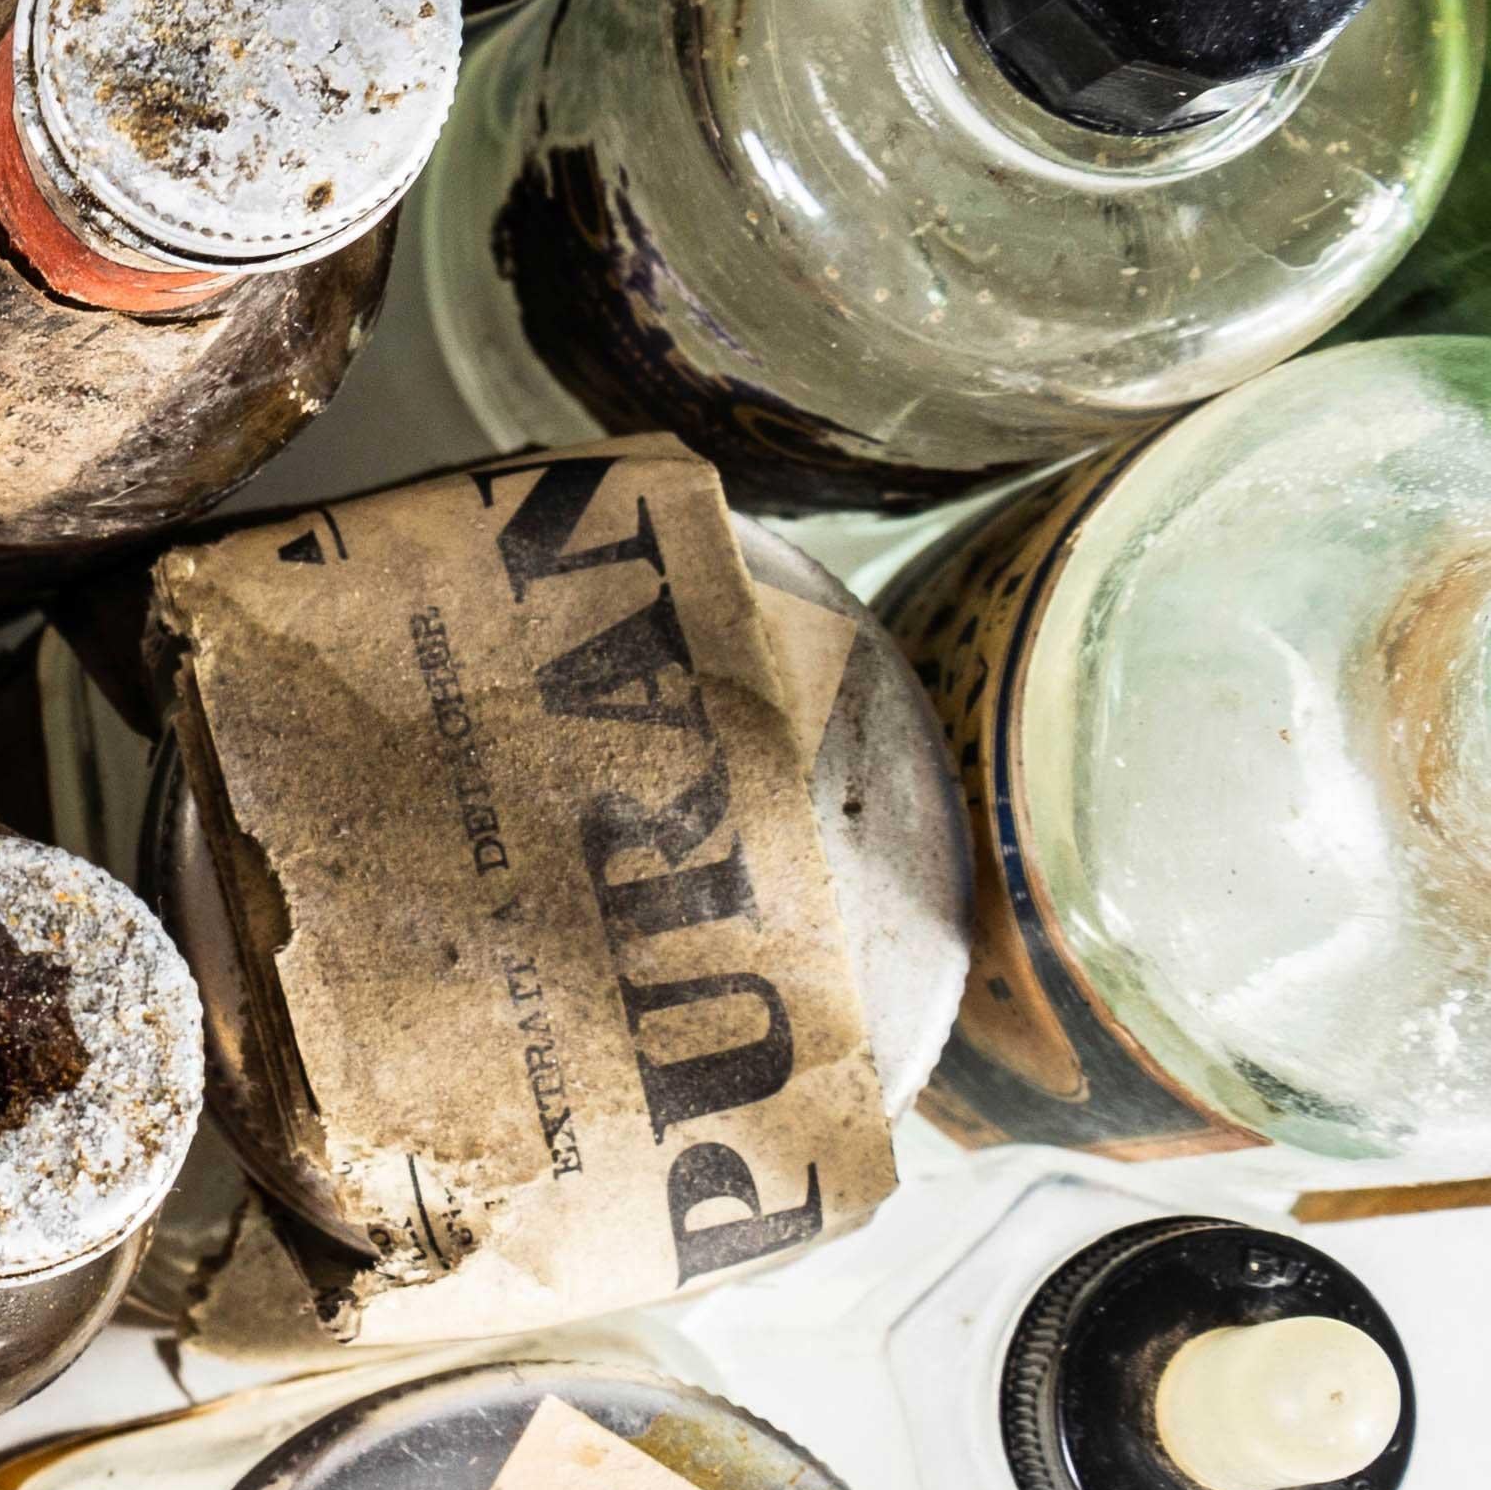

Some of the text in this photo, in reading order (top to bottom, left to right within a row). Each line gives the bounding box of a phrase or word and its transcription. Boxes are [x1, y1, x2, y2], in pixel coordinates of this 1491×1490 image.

[276, 527, 327, 567] A
[467, 455, 824, 1289] PURAN
[505, 952, 584, 1181] EXTRAIT
